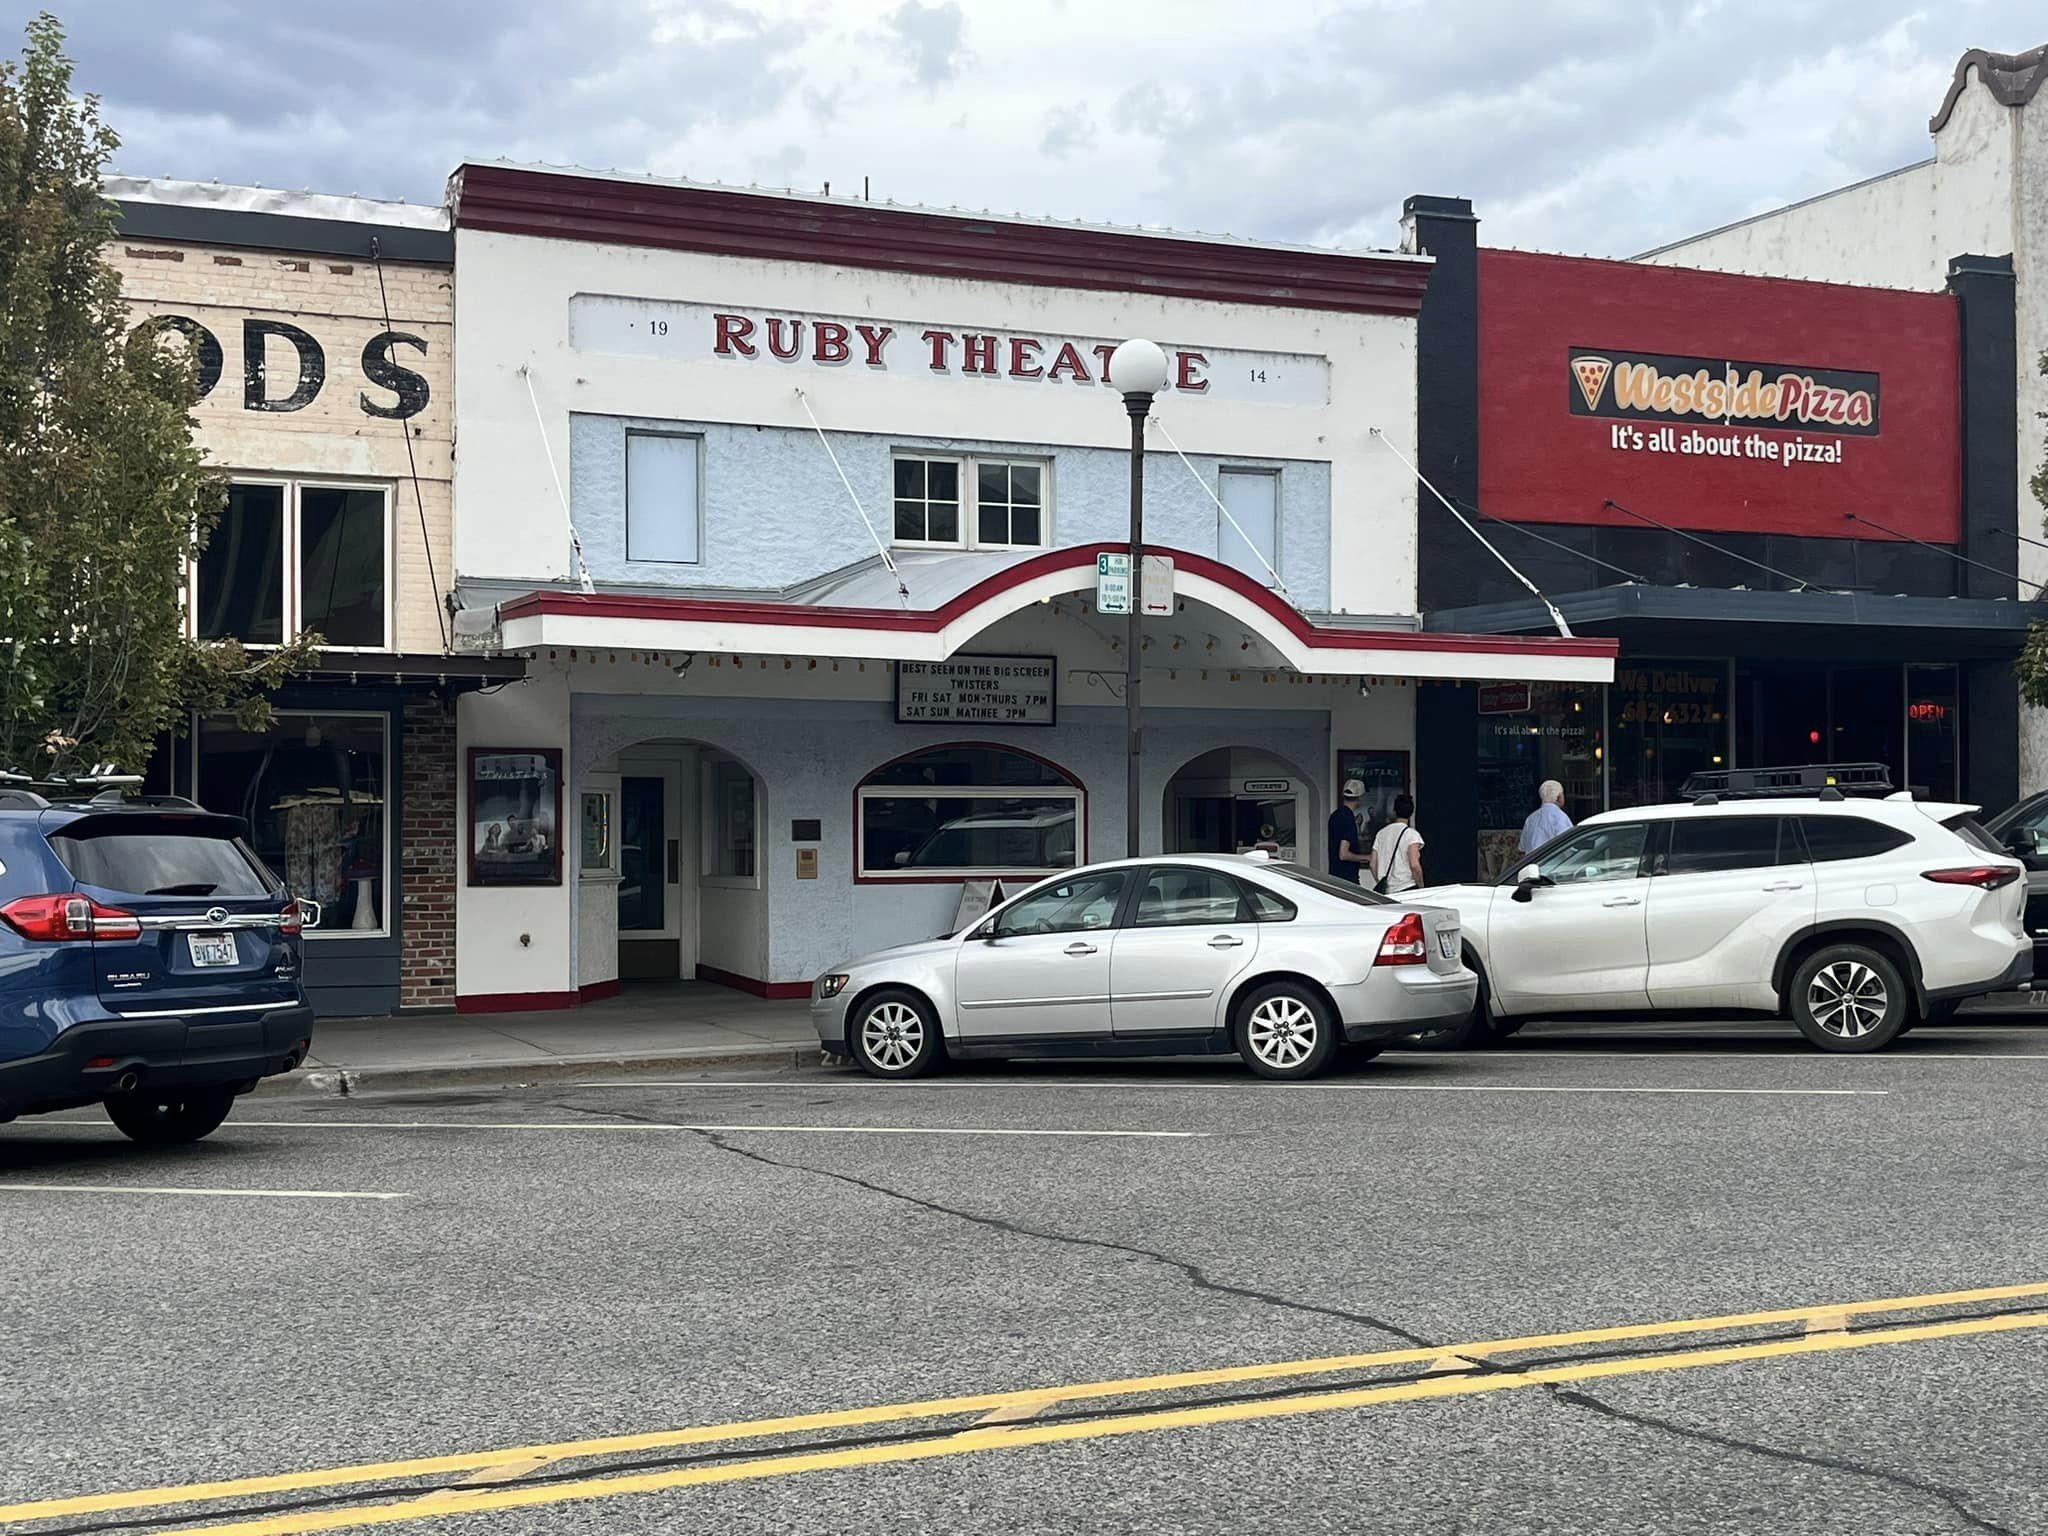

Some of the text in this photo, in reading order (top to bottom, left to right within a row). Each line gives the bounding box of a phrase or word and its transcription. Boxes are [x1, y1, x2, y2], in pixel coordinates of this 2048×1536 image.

[650, 321, 668, 336] 19
[713, 313, 1211, 392] RUBY THEATE
[1249, 369, 1266, 383] 14
[1611, 424, 1842, 467] It's all about the pizza!
[1100, 558, 1107, 572] 3
[902, 663, 1050, 677] BEST SEEN ON THE BIG SCREEN
[951, 679, 1000, 690] TWISTERS
[1618, 671, 1648, 691] We
[912, 692, 928, 703] FRI
[933, 692, 952, 703] SAT
[959, 693, 1018, 705] MON-THURS
[906, 706, 1026, 718] SAT SUN MATINEE 3PM
[1909, 704, 1944, 719] OPEN
[1494, 725, 1507, 735] It's
[1509, 725, 1520, 736] all
[1547, 726, 1560, 736] the
[107, 972, 150, 982] SUBARU
